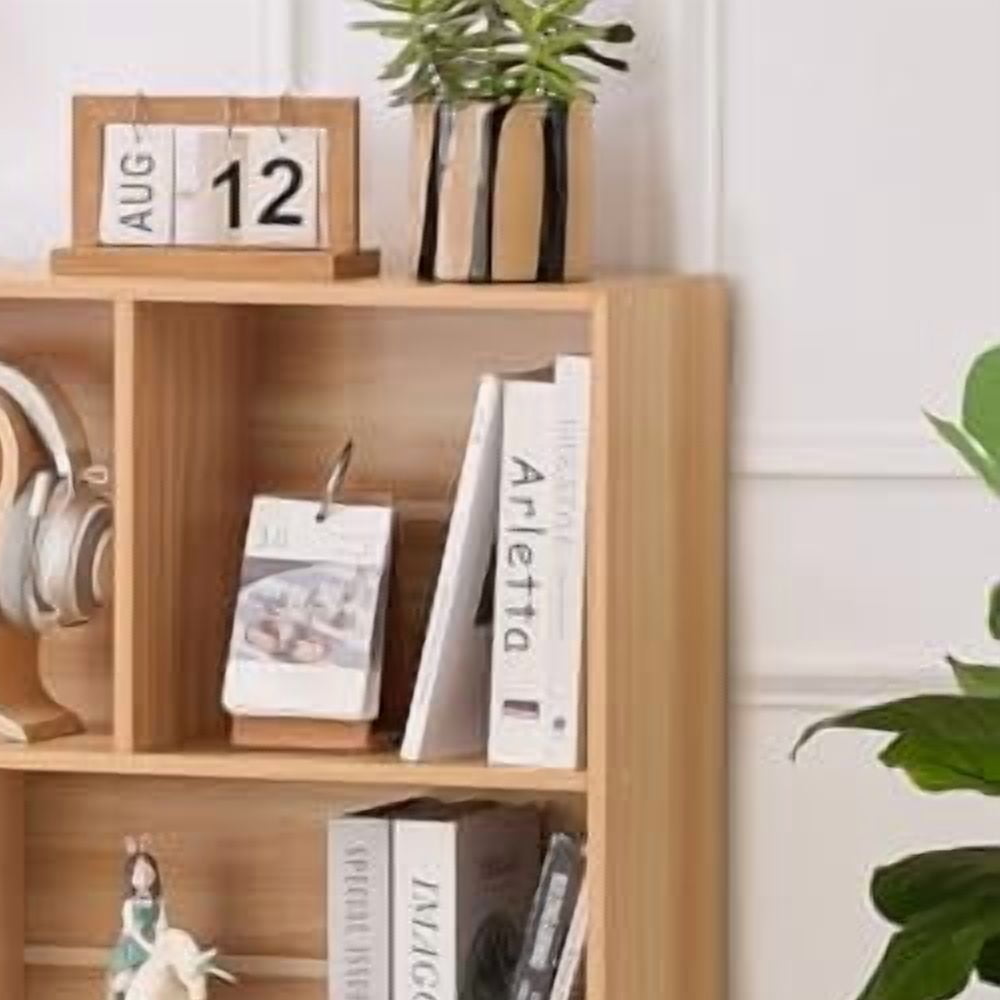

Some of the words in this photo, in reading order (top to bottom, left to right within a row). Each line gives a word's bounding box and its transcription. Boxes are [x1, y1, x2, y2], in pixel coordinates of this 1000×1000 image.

[118, 152, 156, 233] AUG
[212, 157, 305, 229] 12
[503, 456, 547, 653] Arletta
